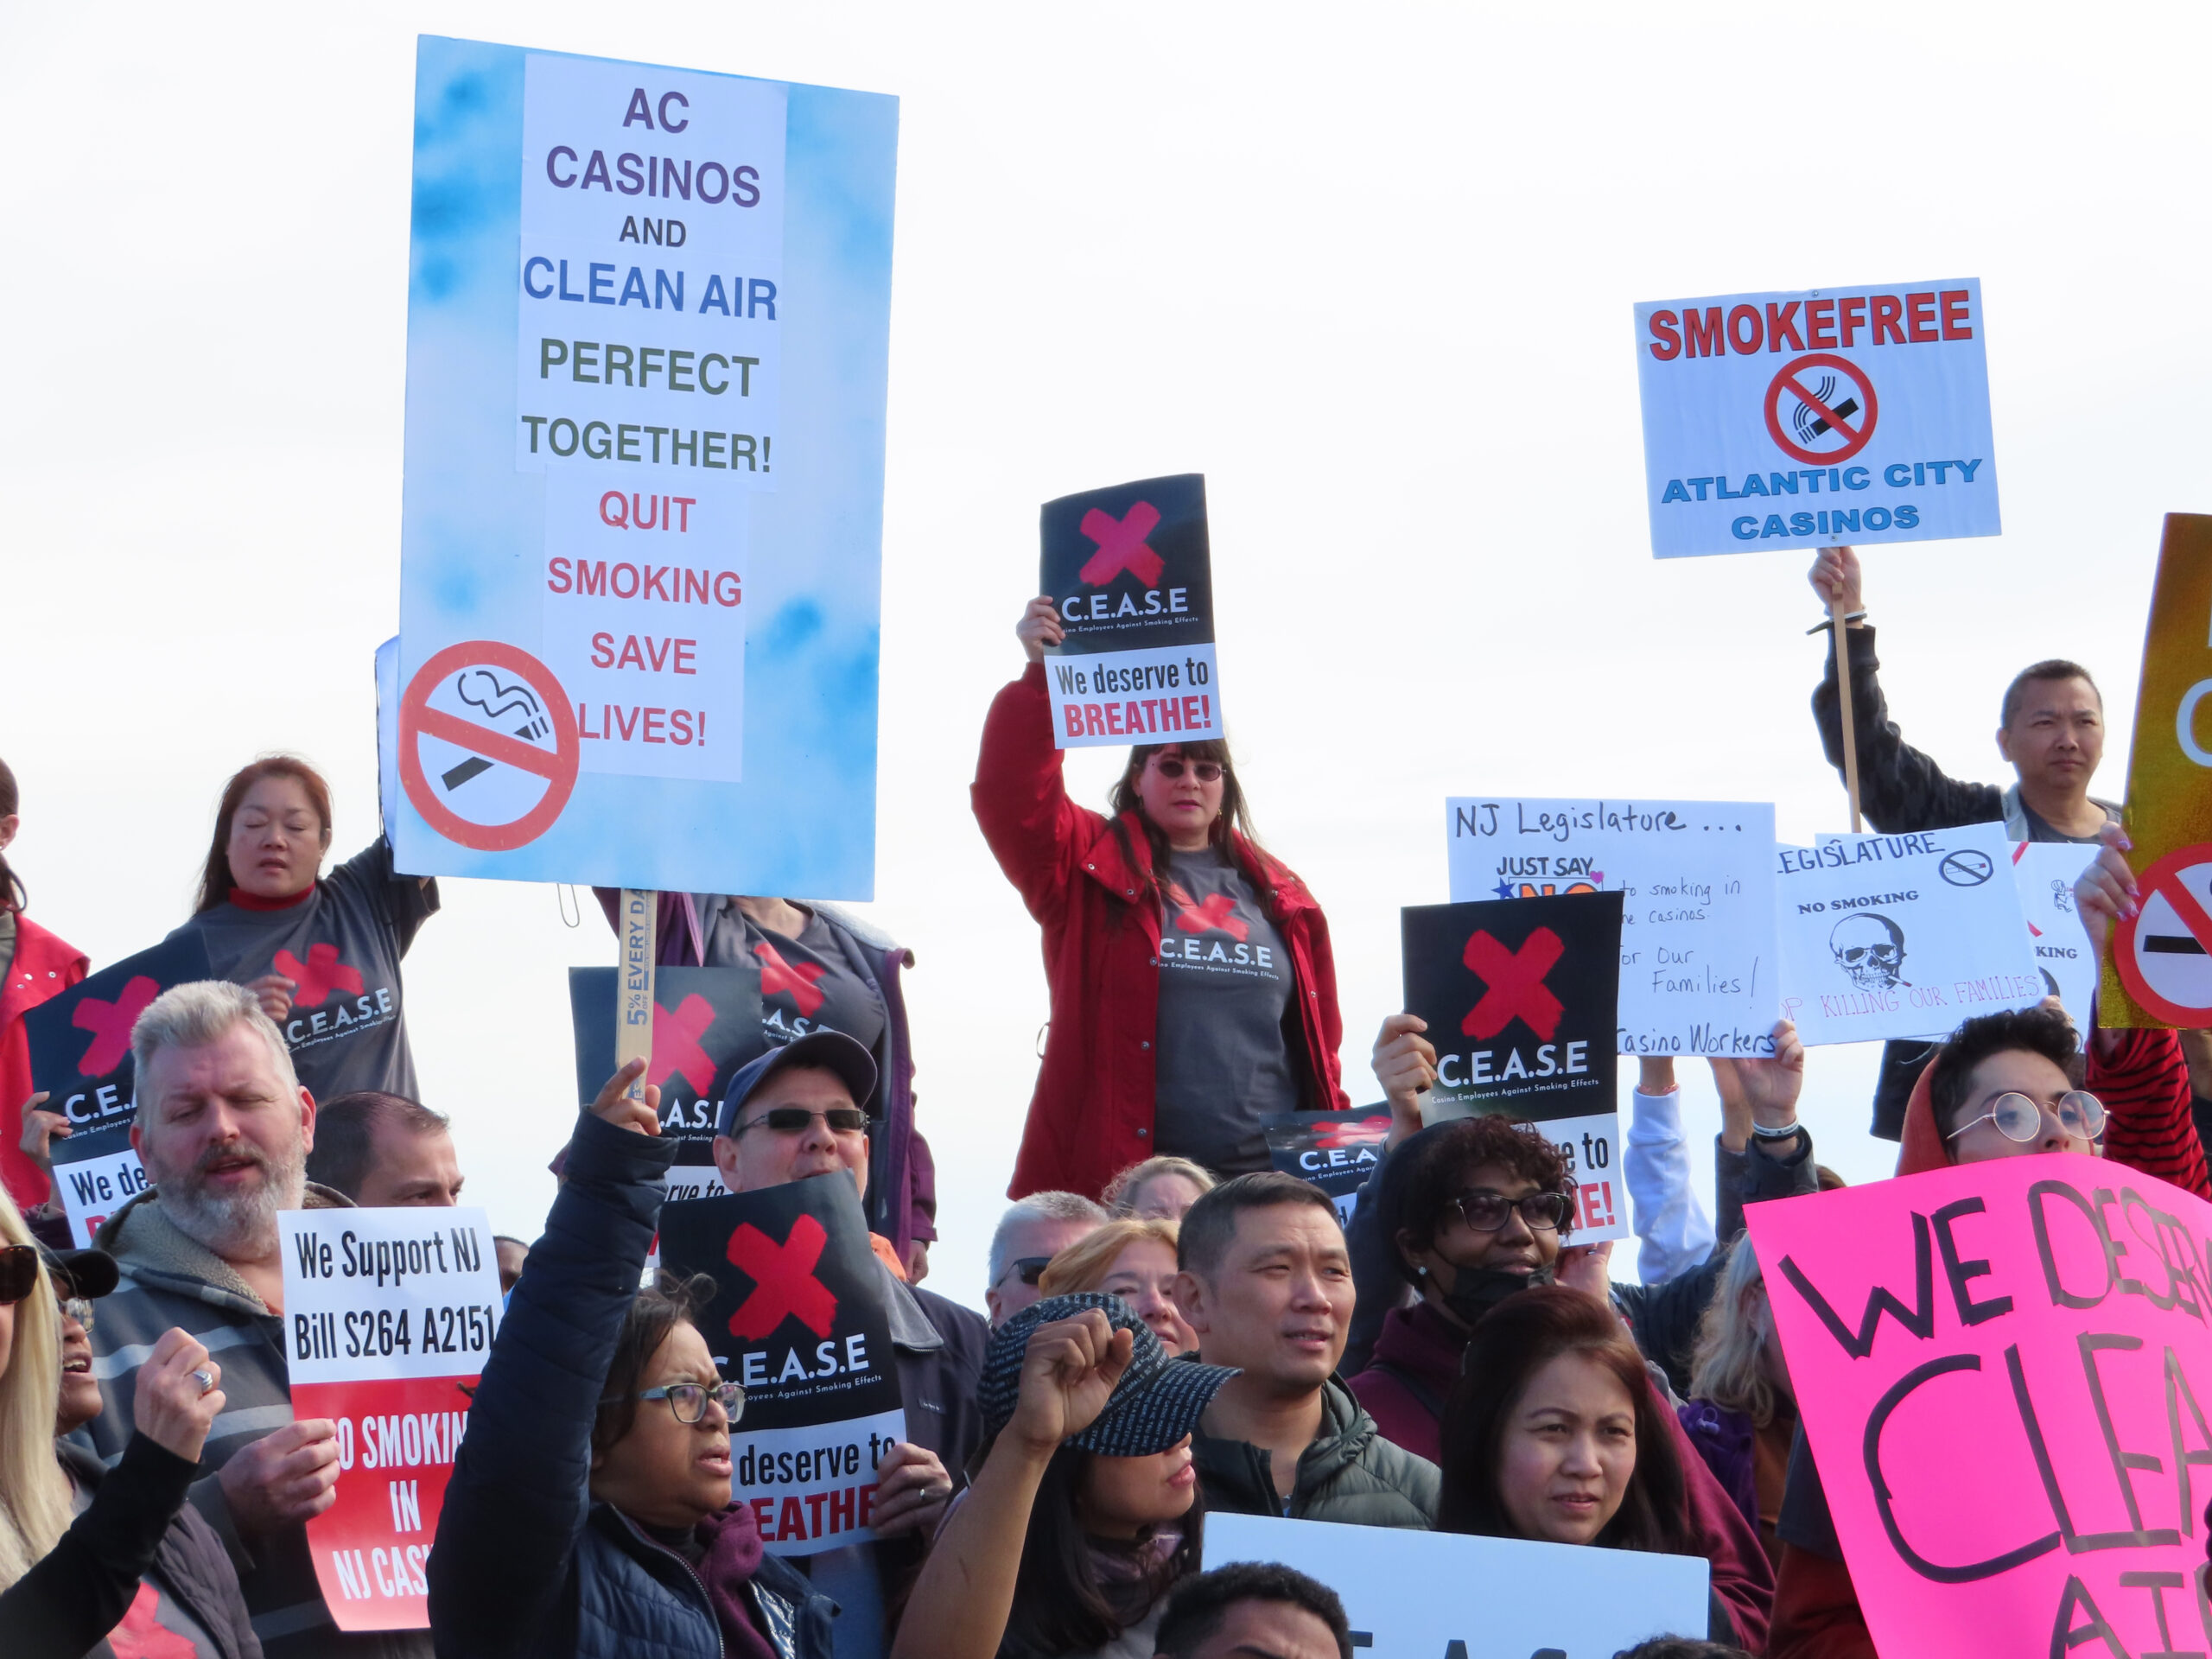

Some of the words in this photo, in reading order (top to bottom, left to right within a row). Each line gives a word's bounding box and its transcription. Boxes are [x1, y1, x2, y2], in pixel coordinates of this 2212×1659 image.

[622, 87, 690, 134] AC
[546, 145, 761, 208] CASINOS
[619, 215, 687, 248] AND
[523, 256, 684, 312] CLEAN
[698, 274, 777, 321] AIR
[1649, 289, 1973, 361] SMOKEFREE
[540, 338, 760, 397] PERFECT
[521, 415, 771, 474] TOGETHER!
[1661, 467, 1871, 504] ATLANTIC
[1884, 459, 1983, 488] CITY
[599, 490, 696, 533] QUIT
[1731, 505, 1920, 540] CASINOS
[547, 556, 742, 607] SMOKING
[1061, 587, 1189, 622] C.E.A.S.E
[1116, 621, 1141, 630] Against
[1144, 618, 1173, 626] Smoking
[590, 632, 698, 675] SAVE
[1054, 664, 1087, 696] We
[1093, 662, 1179, 695] deserve
[1185, 657, 1209, 686] to
[578, 702, 706, 747] LIVES!
[1063, 694, 1212, 738] BREATHE!
[1456, 804, 1499, 838] NJ
[1517, 800, 1687, 842] Legislature
[1496, 856, 1549, 876] JUST
[1554, 856, 1593, 877] SAY
[1649, 876, 1712, 906] smoking
[1725, 874, 1740, 895] in
[1797, 901, 1825, 915] NO
[1830, 890, 1919, 911] SMOKING
[628, 920, 645, 991] EVERY
[1160, 938, 1273, 969] C.E.A.S.E
[1657, 946, 1694, 964] Our
[2035, 945, 2078, 959] KING
[287, 987, 393, 1044] C.E.A.S.E
[1820, 989, 1901, 1018] KILLING
[1909, 986, 1948, 1008] OUR
[1954, 975, 2040, 1003] FAMILIES
[1689, 1022, 1776, 1053] Workers
[1436, 1039, 1589, 1088] C.E.A.S.E
[1431, 1095, 1456, 1104] Casino
[1458, 1090, 1499, 1102] Employees
[1501, 1086, 1532, 1096] Against
[1534, 1081, 1568, 1092] Smoking
[1570, 1077, 1599, 1088] Effects
[89, 1117, 130, 1134] Employees
[1581, 1132, 1609, 1170] to
[69, 1170, 114, 1206] We
[1317, 1169, 1354, 1179] Employees
[295, 1231, 334, 1280] We
[341, 1230, 448, 1287] Support
[454, 1226, 482, 1274] NJ
[1777, 1196, 2014, 1361] WE
[2026, 1179, 2212, 1330] DESER
[295, 1312, 338, 1361] Bill
[345, 1308, 412, 1359] S264
[422, 1304, 496, 1355] A2151
[778, 1388, 812, 1400] Against
[816, 1381, 852, 1394] Smoking
[855, 1374, 882, 1387] Effects
[739, 1443, 860, 1487] deserve
[390, 1479, 422, 1532] IN
[332, 1548, 372, 1599] NJ
